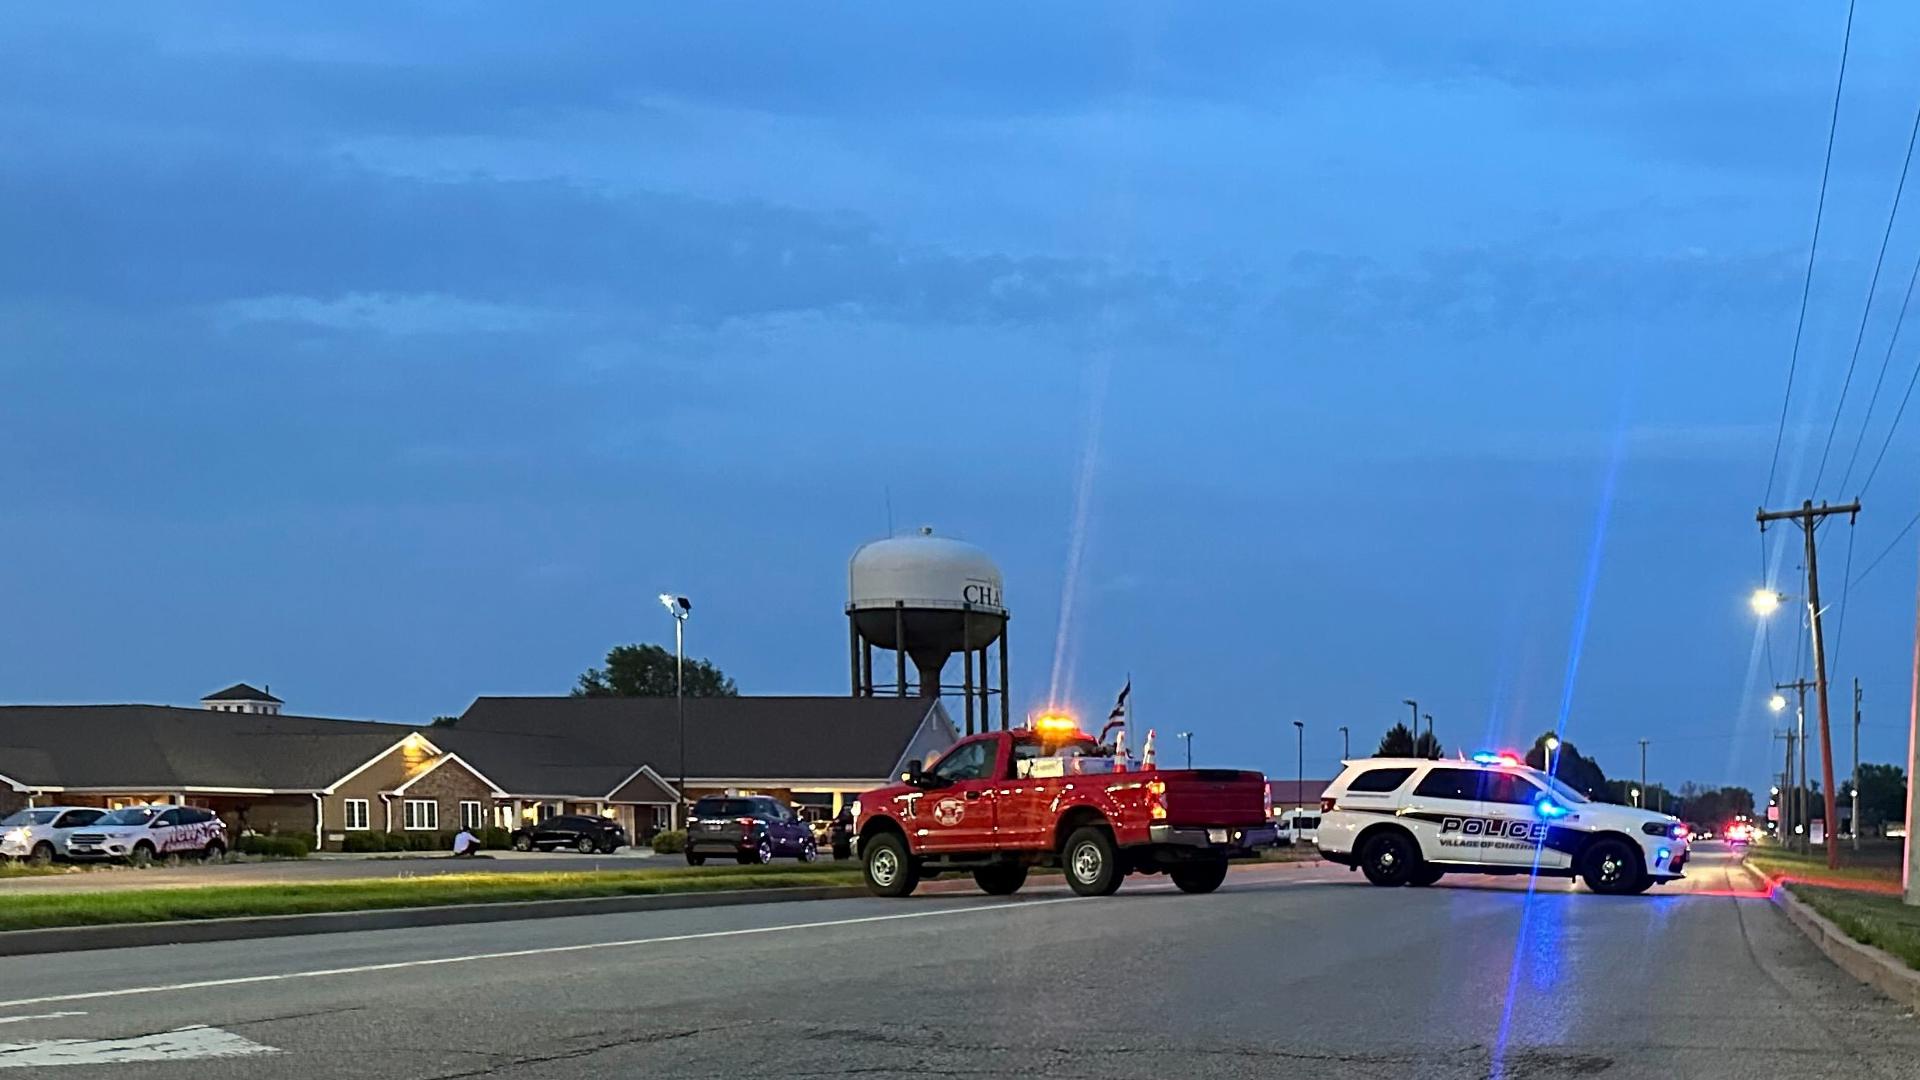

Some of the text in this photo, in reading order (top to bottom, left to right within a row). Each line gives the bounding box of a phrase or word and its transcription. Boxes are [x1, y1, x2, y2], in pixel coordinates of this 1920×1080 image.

[1441, 817, 1548, 840] POLICE
[1440, 839, 1480, 848] VILLAGE
[1494, 841, 1542, 850] CHATHA
